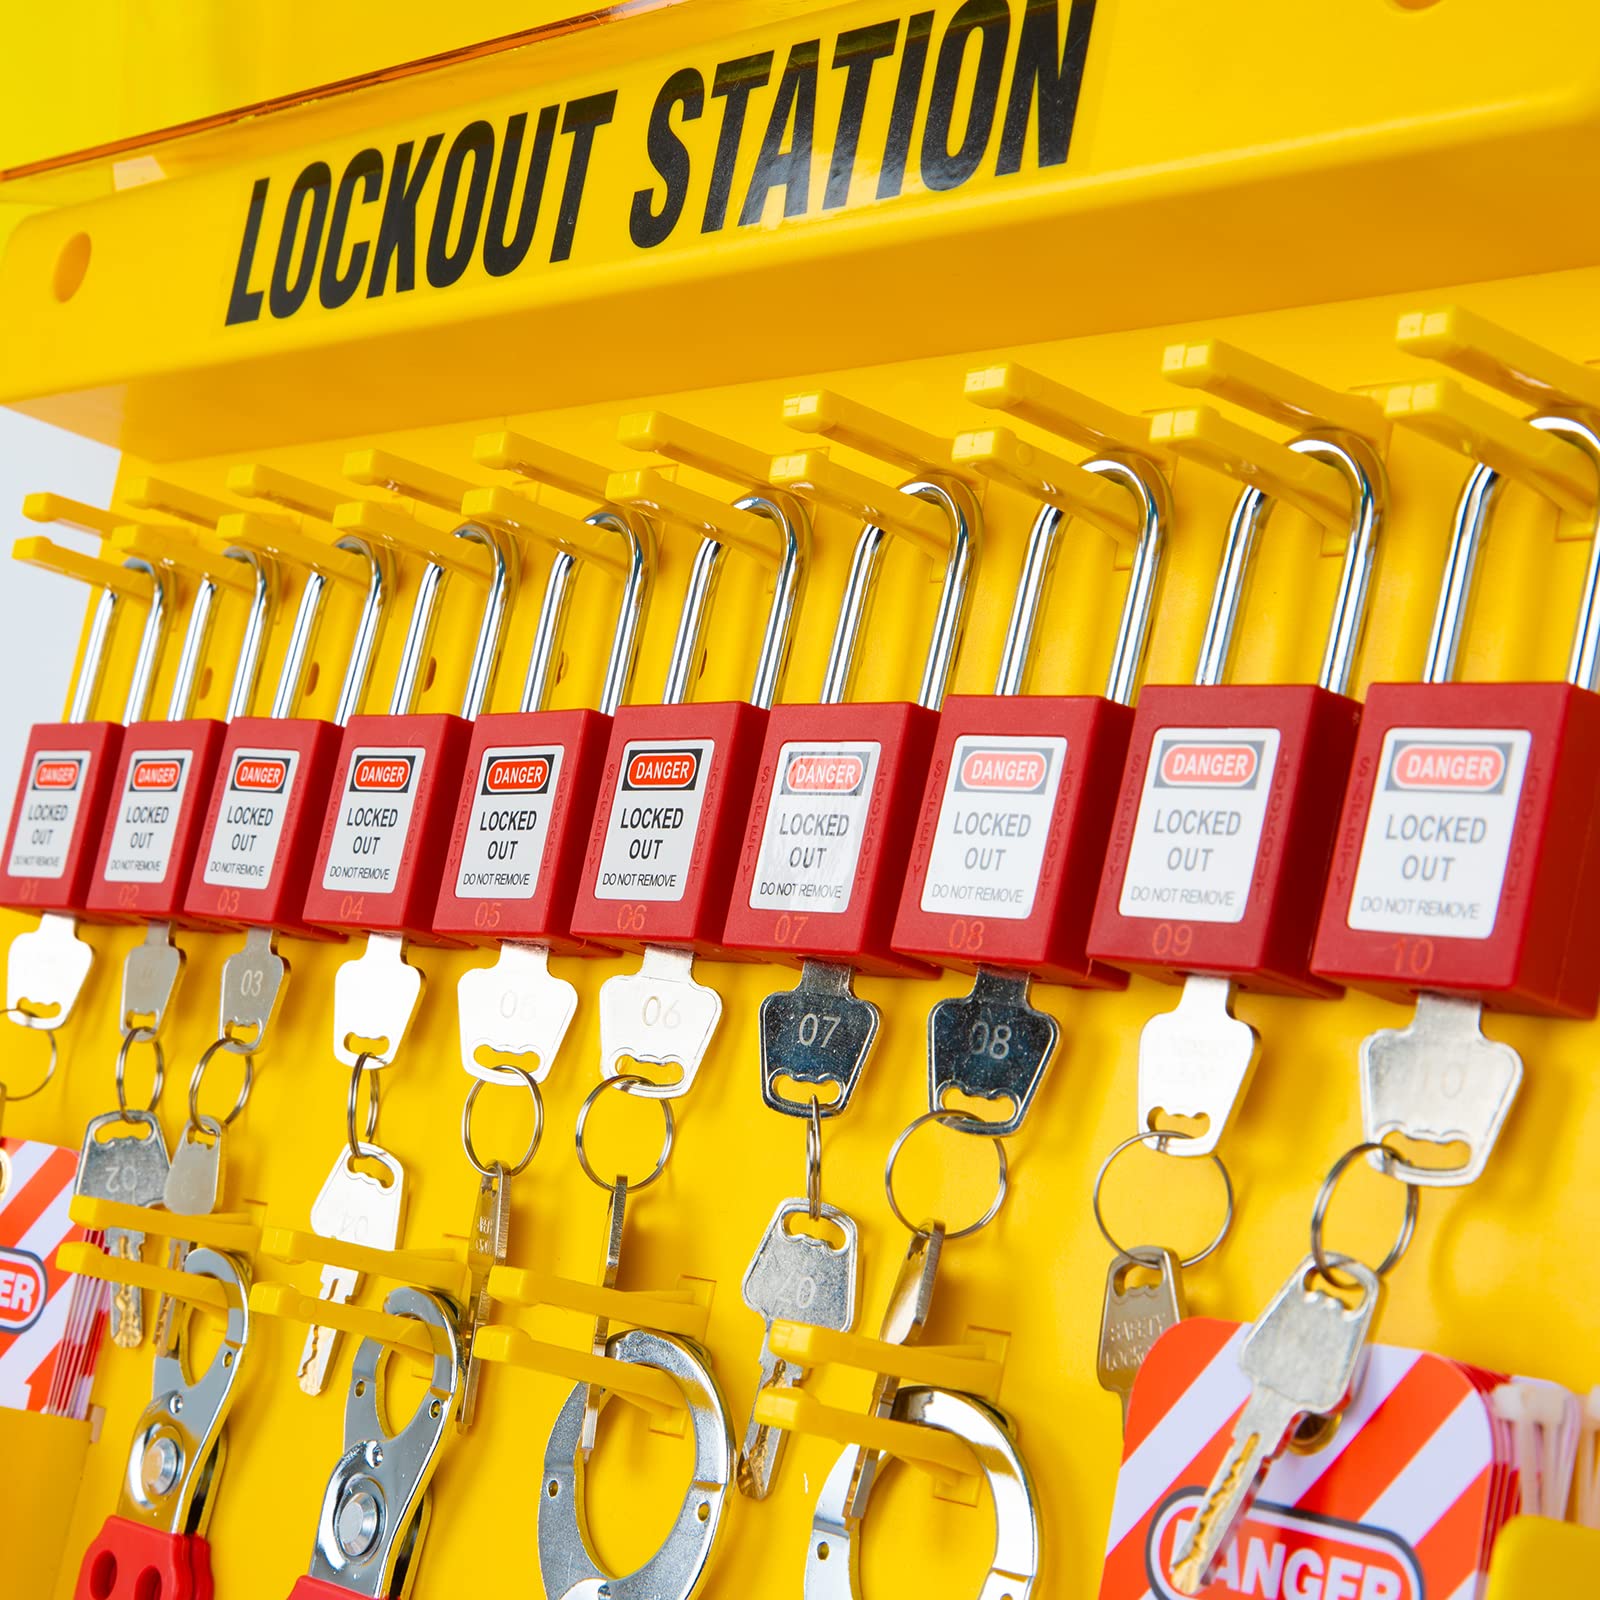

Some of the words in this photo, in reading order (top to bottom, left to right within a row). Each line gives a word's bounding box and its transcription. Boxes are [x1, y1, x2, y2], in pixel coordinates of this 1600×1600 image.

[225, 89, 618, 327] LOCKOUT
[629, 0, 1097, 249] STATION
[40, 767, 75, 783] DANGER
[138, 767, 176, 783] DANGER
[240, 766, 281, 784] DANGER
[360, 766, 405, 783] DANGER
[494, 767, 543, 784] DANGER
[636, 761, 690, 779] DANGER
[796, 764, 856, 784] DANGER
[971, 759, 1038, 782] DANGER
[1172, 753, 1249, 777] DANGER
[1406, 755, 1494, 780] DANGER
[28, 805, 68, 821] LOCKED
[126, 806, 169, 824] LOCKED
[227, 806, 274, 827] LOCKED
[347, 808, 398, 828] LOCKED
[480, 810, 537, 831] LOCKED
[620, 808, 684, 829] LOCKED
[1153, 809, 1241, 836] LOCKED
[779, 813, 850, 837] LOCKED
[953, 811, 1031, 838] LOCKED
[1385, 814, 1487, 844] LOCKED
[32, 829, 53, 845] OUT
[130, 832, 154, 849] OUT
[231, 833, 256, 852] OUT
[353, 836, 380, 855] OUT
[488, 840, 518, 860] OUT
[629, 839, 663, 860] OUT
[789, 847, 827, 868] OUT
[964, 847, 1007, 871] OUT
[1167, 847, 1214, 872] OUT
[210, 861, 221, 873] DO
[221, 862, 236, 874] NOT
[236, 864, 264, 877] REMOVE
[330, 866, 341, 877] DO
[342, 867, 359, 878] NOT
[358, 868, 390, 880] REMOVE
[463, 873, 476, 885] DO
[477, 874, 495, 885] NOT
[495, 874, 530, 885] REMOVE
[1401, 855, 1455, 882] OUT
[602, 873, 617, 885] DO
[617, 873, 638, 886] NOT
[639, 874, 677, 887] REMOVE
[760, 882, 776, 896] DO
[777, 883, 798, 896] NOT
[800, 883, 843, 899] REMOVE
[217, 889, 240, 913] 03
[932, 884, 949, 898] DO
[950, 885, 974, 899] NOT
[976, 887, 1024, 904] REMOVE
[1131, 885, 1151, 901] DO
[1152, 887, 1178, 903] NOT
[1180, 888, 1236, 907] REMOVE
[340, 895, 365, 921] 04
[474, 902, 501, 928] 05
[1360, 896, 1383, 913] DO
[1384, 897, 1416, 915] NOT
[1417, 899, 1480, 920] REMOVE
[774, 914, 809, 944] 07
[949, 919, 985, 950] 08
[1152, 923, 1193, 957] 09
[1392, 938, 1434, 975] 10
[240, 969, 263, 996] 03
[642, 995, 682, 1029] 06
[799, 1012, 842, 1049] 07
[971, 1021, 1012, 1060] 08
[104, 1165, 139, 1194] 02
